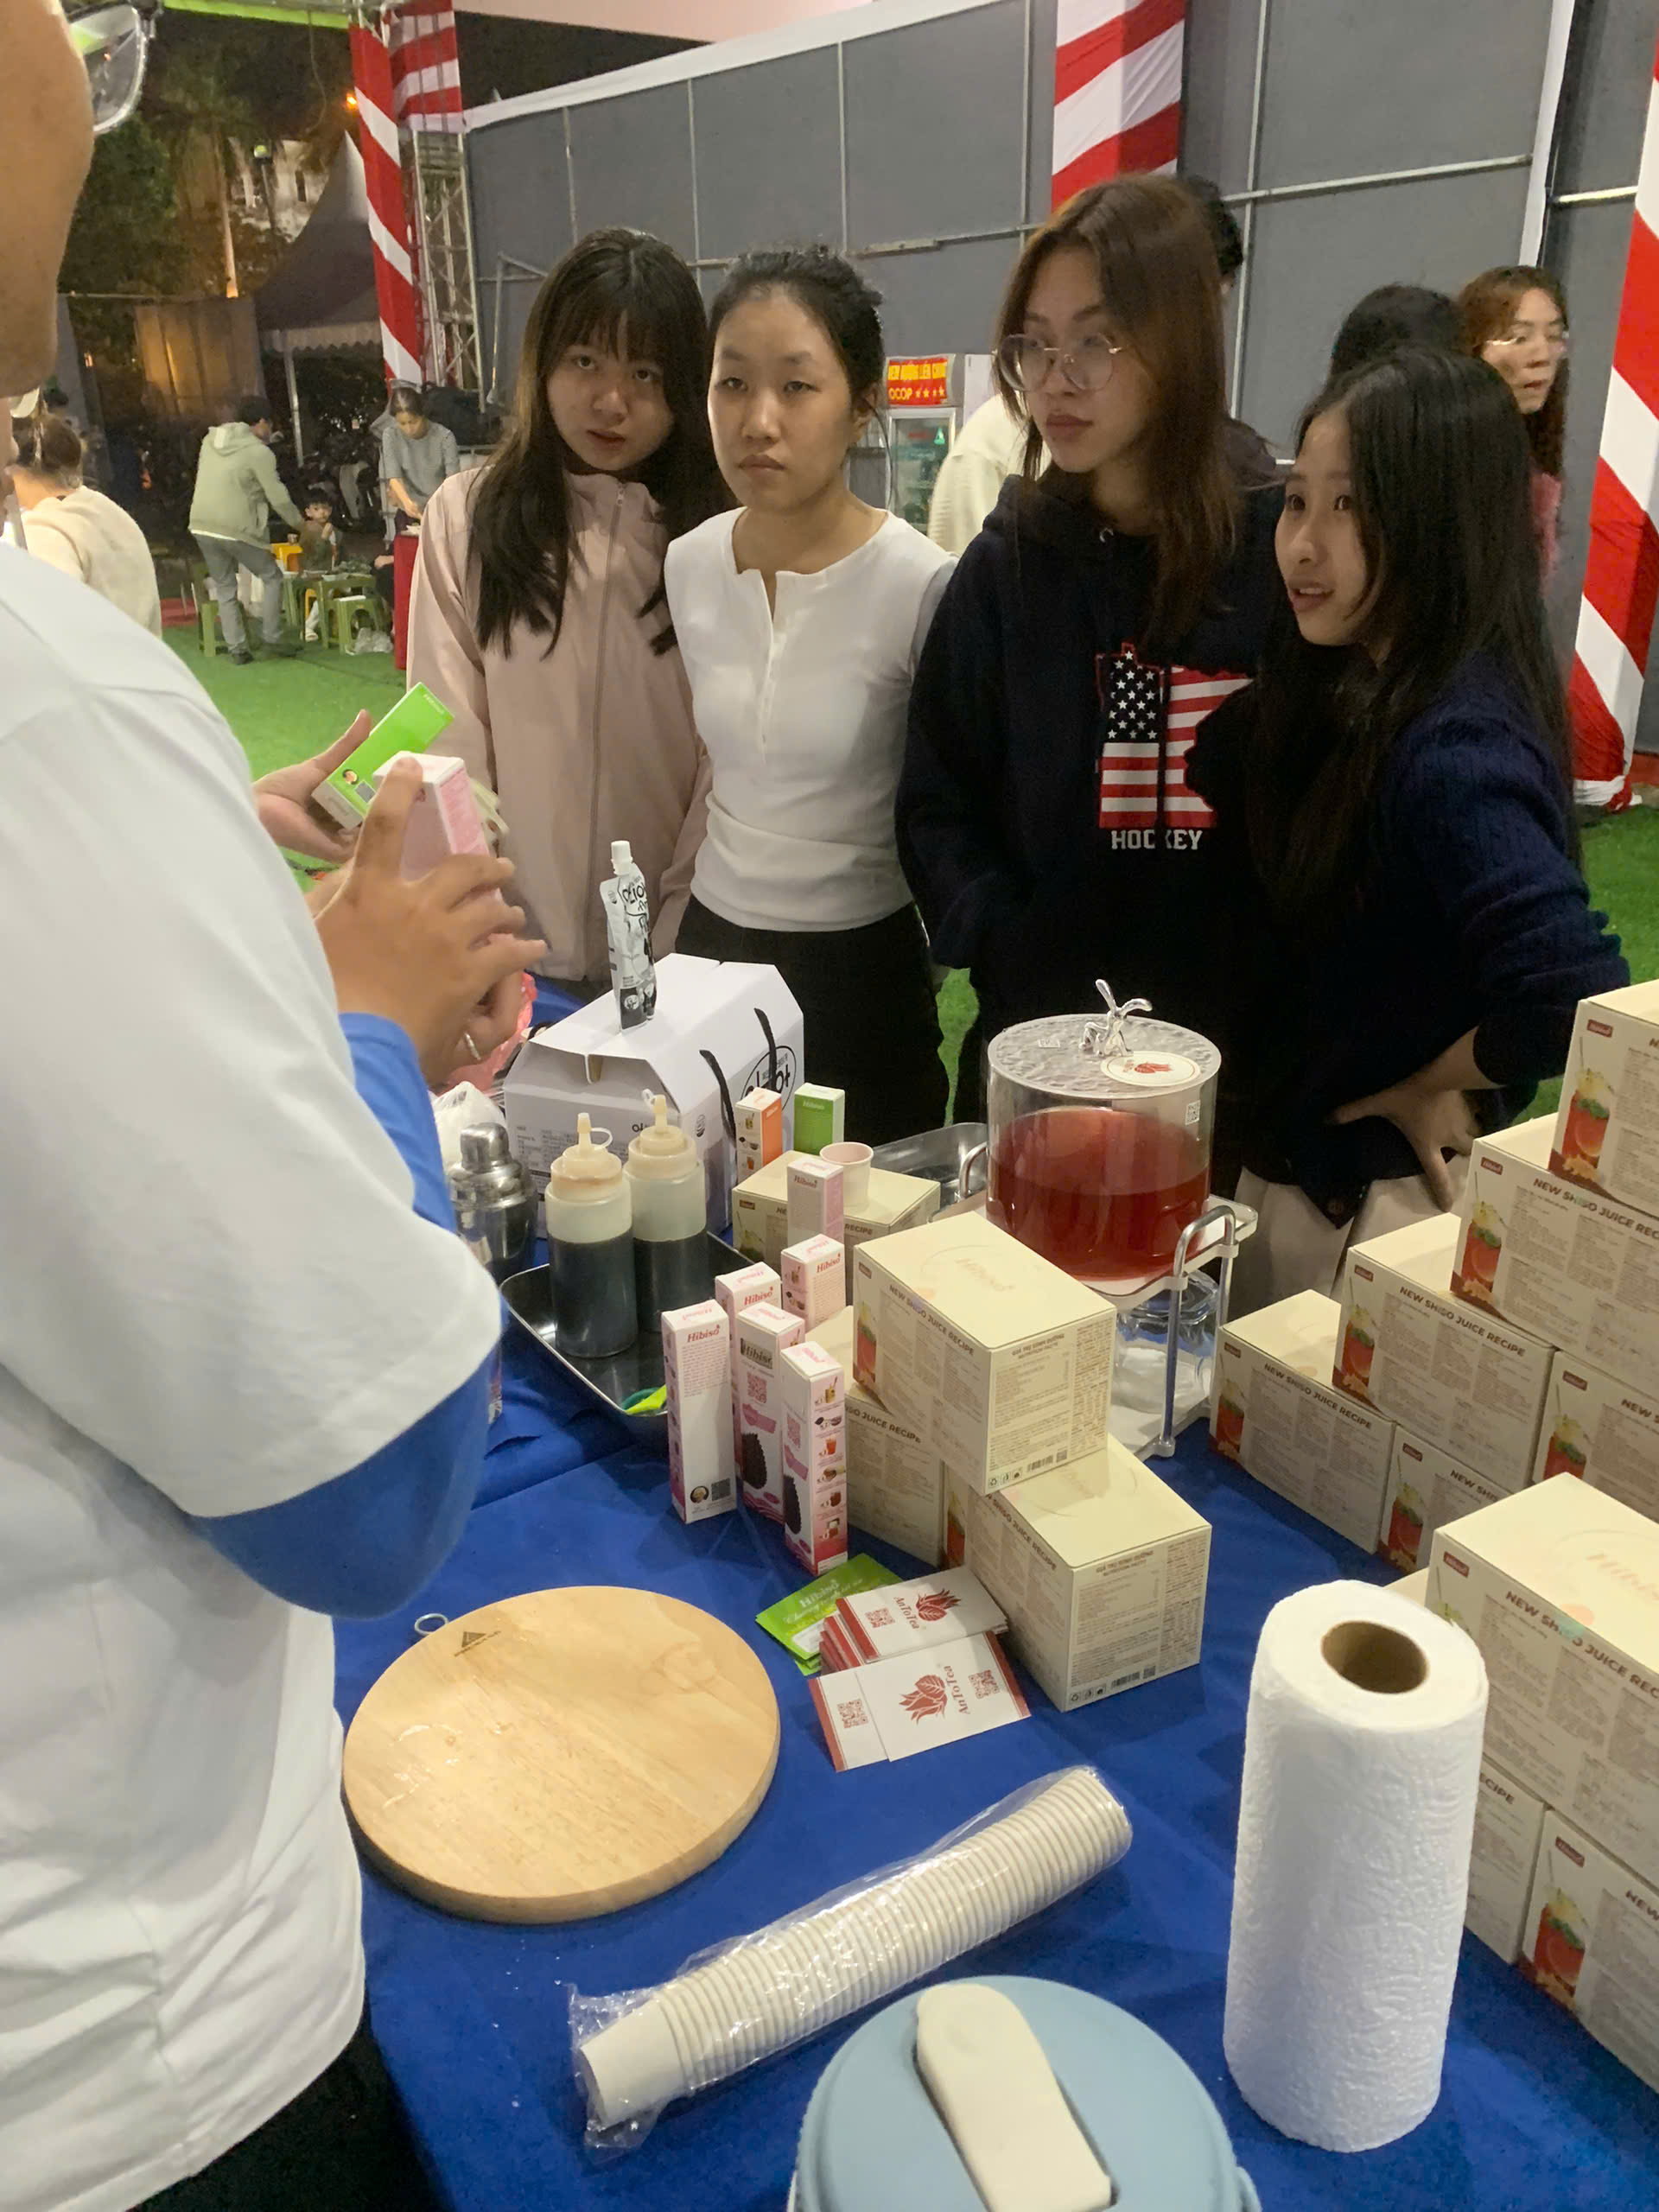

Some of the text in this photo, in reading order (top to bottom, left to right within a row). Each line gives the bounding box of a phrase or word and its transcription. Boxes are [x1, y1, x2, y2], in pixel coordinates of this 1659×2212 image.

[1533, 1178, 1562, 1196] NEW
[1599, 1206, 1635, 1228] JUICE
[817, 1253, 841, 1273] Hibiso
[744, 1287, 773, 1306] Hibiso
[687, 1324, 721, 1342] Hibiso
[1399, 1286, 1424, 1303] NEW
[1456, 1316, 1485, 1336] JUICE
[1486, 1331, 1527, 1357] RECIPE
[1264, 1363, 1286, 1379] NEW
[1313, 1390, 1338, 1410] JUICE
[1339, 1406, 1372, 1429] RECIPE
[1621, 1399, 1652, 1418] NEW
[861, 1411, 887, 1428] JUICE
[888, 1424, 922, 1444] RECIPE
[1450, 1470, 1476, 1488] NEW
[893, 1596, 920, 1630] AnToTea
[1505, 1591, 1540, 1617] NEW
[1584, 1643, 1629, 1677] JUICE
[944, 1665, 971, 1715] AnToTea
